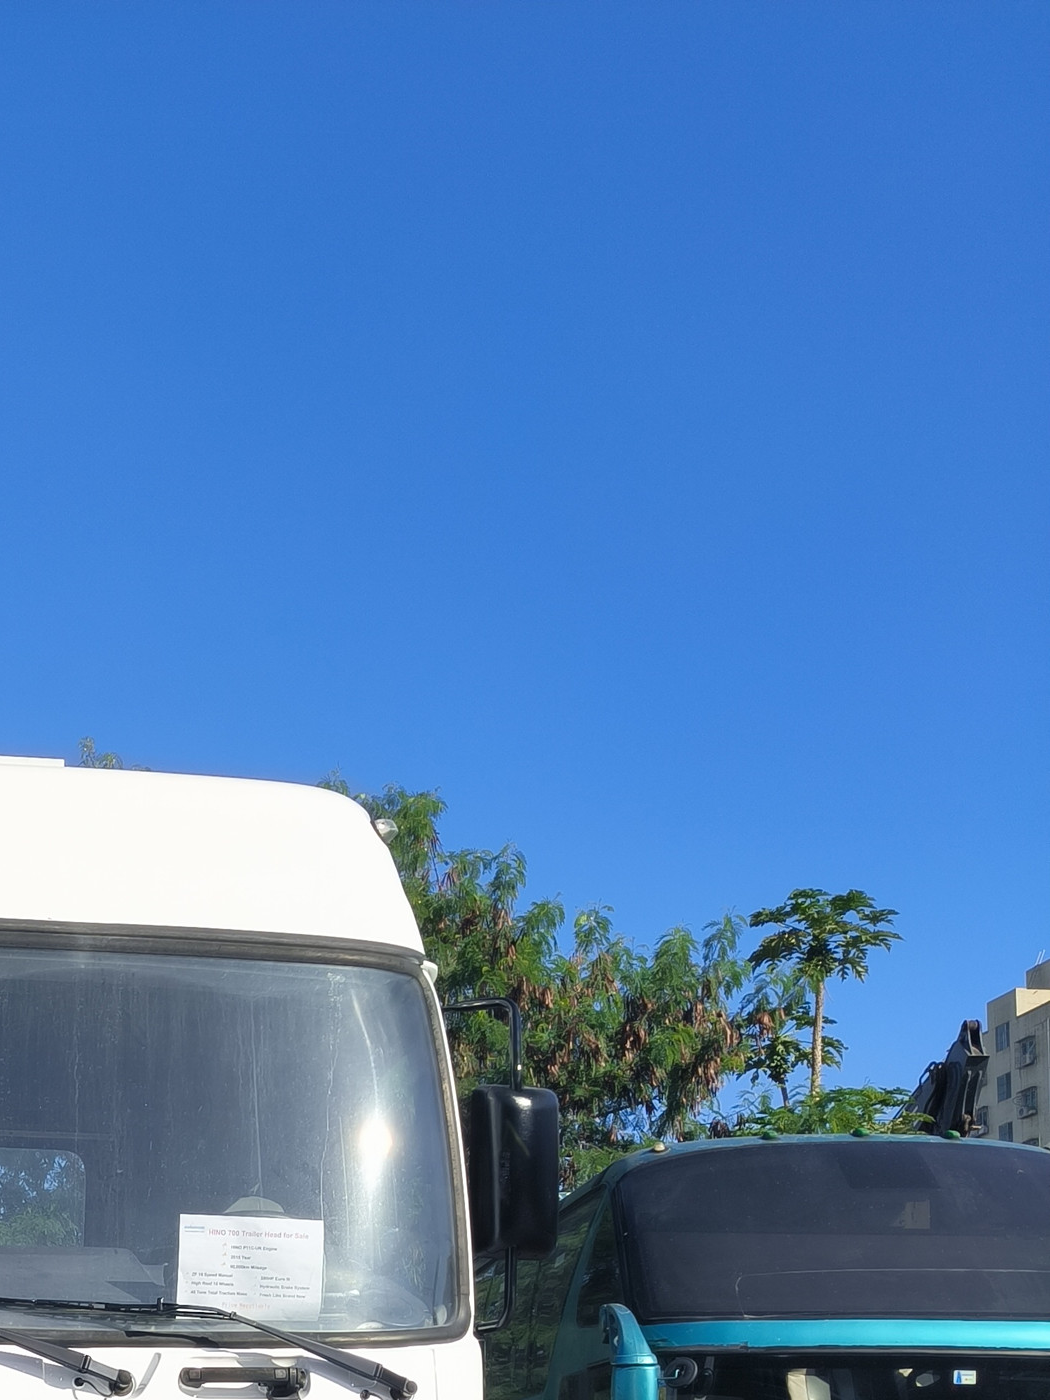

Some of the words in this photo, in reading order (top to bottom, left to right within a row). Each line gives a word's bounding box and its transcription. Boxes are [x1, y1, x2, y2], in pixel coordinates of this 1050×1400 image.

[208, 1228, 227, 1236] HINO
[228, 1229, 240, 1237] 700
[241, 1230, 263, 1238] Trailer
[264, 1231, 282, 1239] Head
[283, 1231, 293, 1239] for
